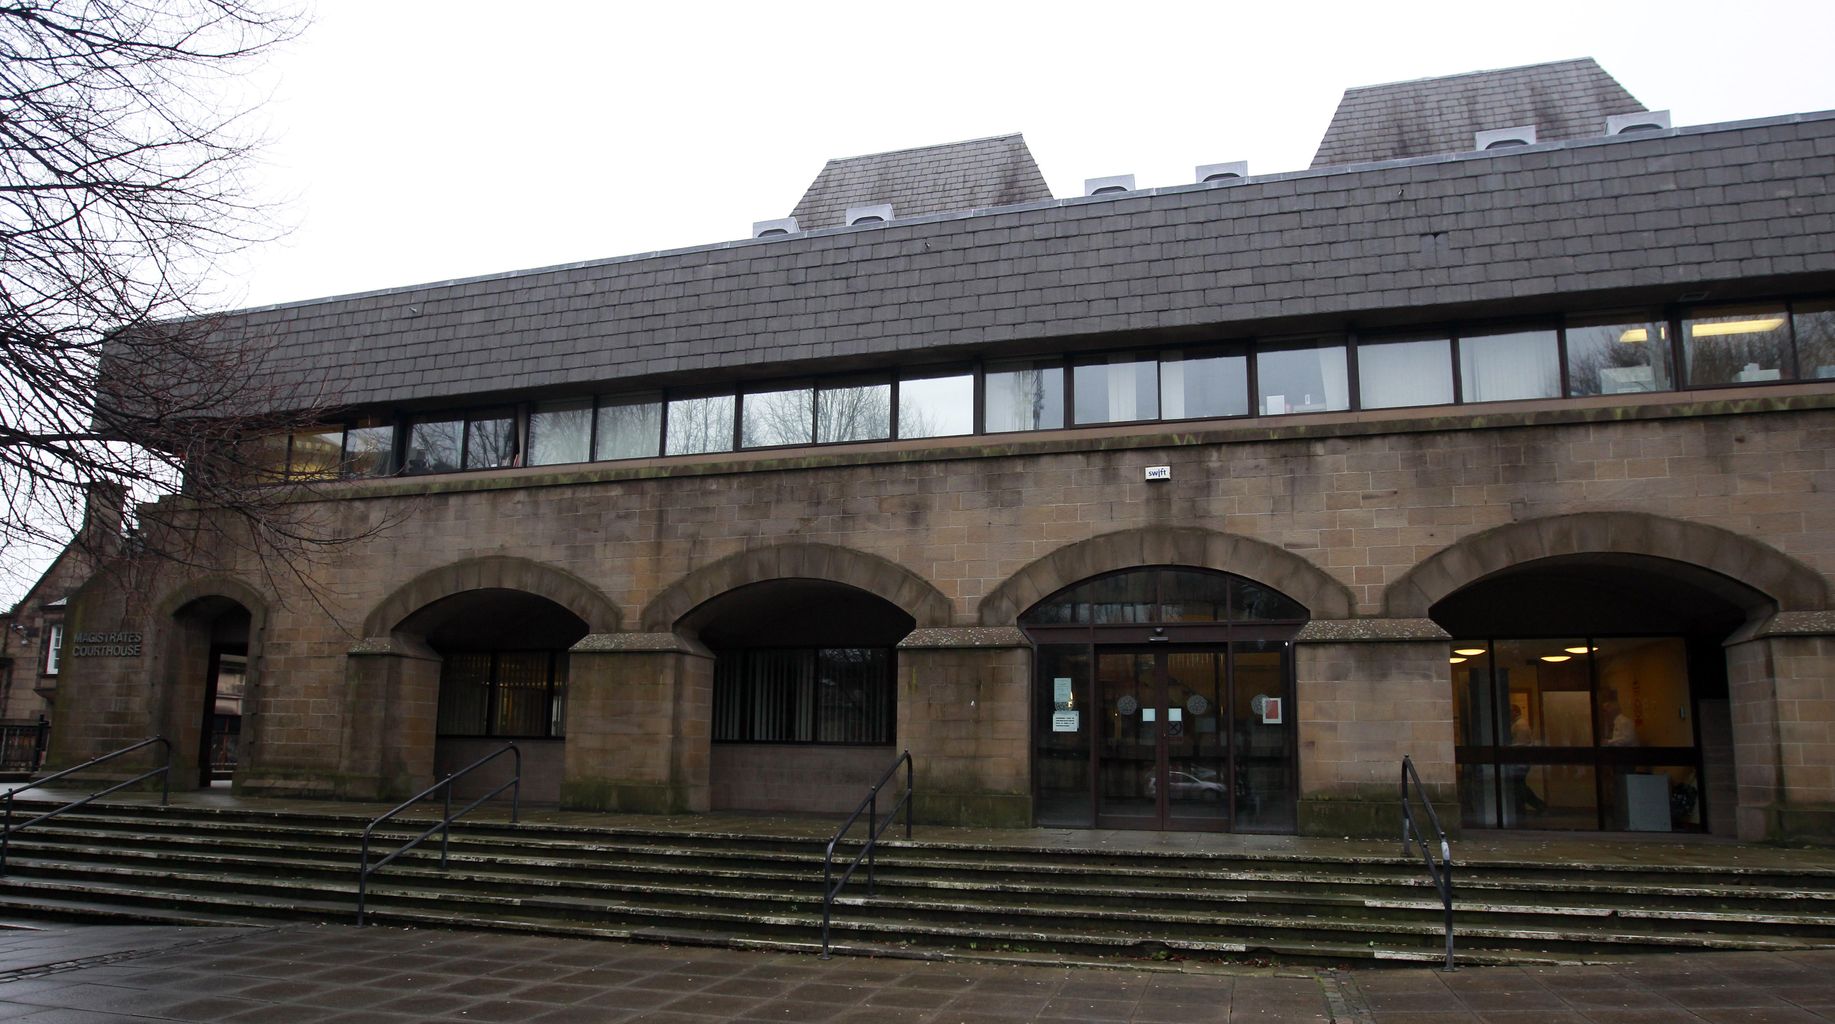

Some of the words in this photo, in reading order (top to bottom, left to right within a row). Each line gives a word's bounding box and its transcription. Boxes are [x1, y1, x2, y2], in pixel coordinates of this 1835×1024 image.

[1148, 468, 1166, 477] swift
[73, 632, 142, 643] MAGISTRATES
[72, 645, 141, 656] COURTHOUSE
